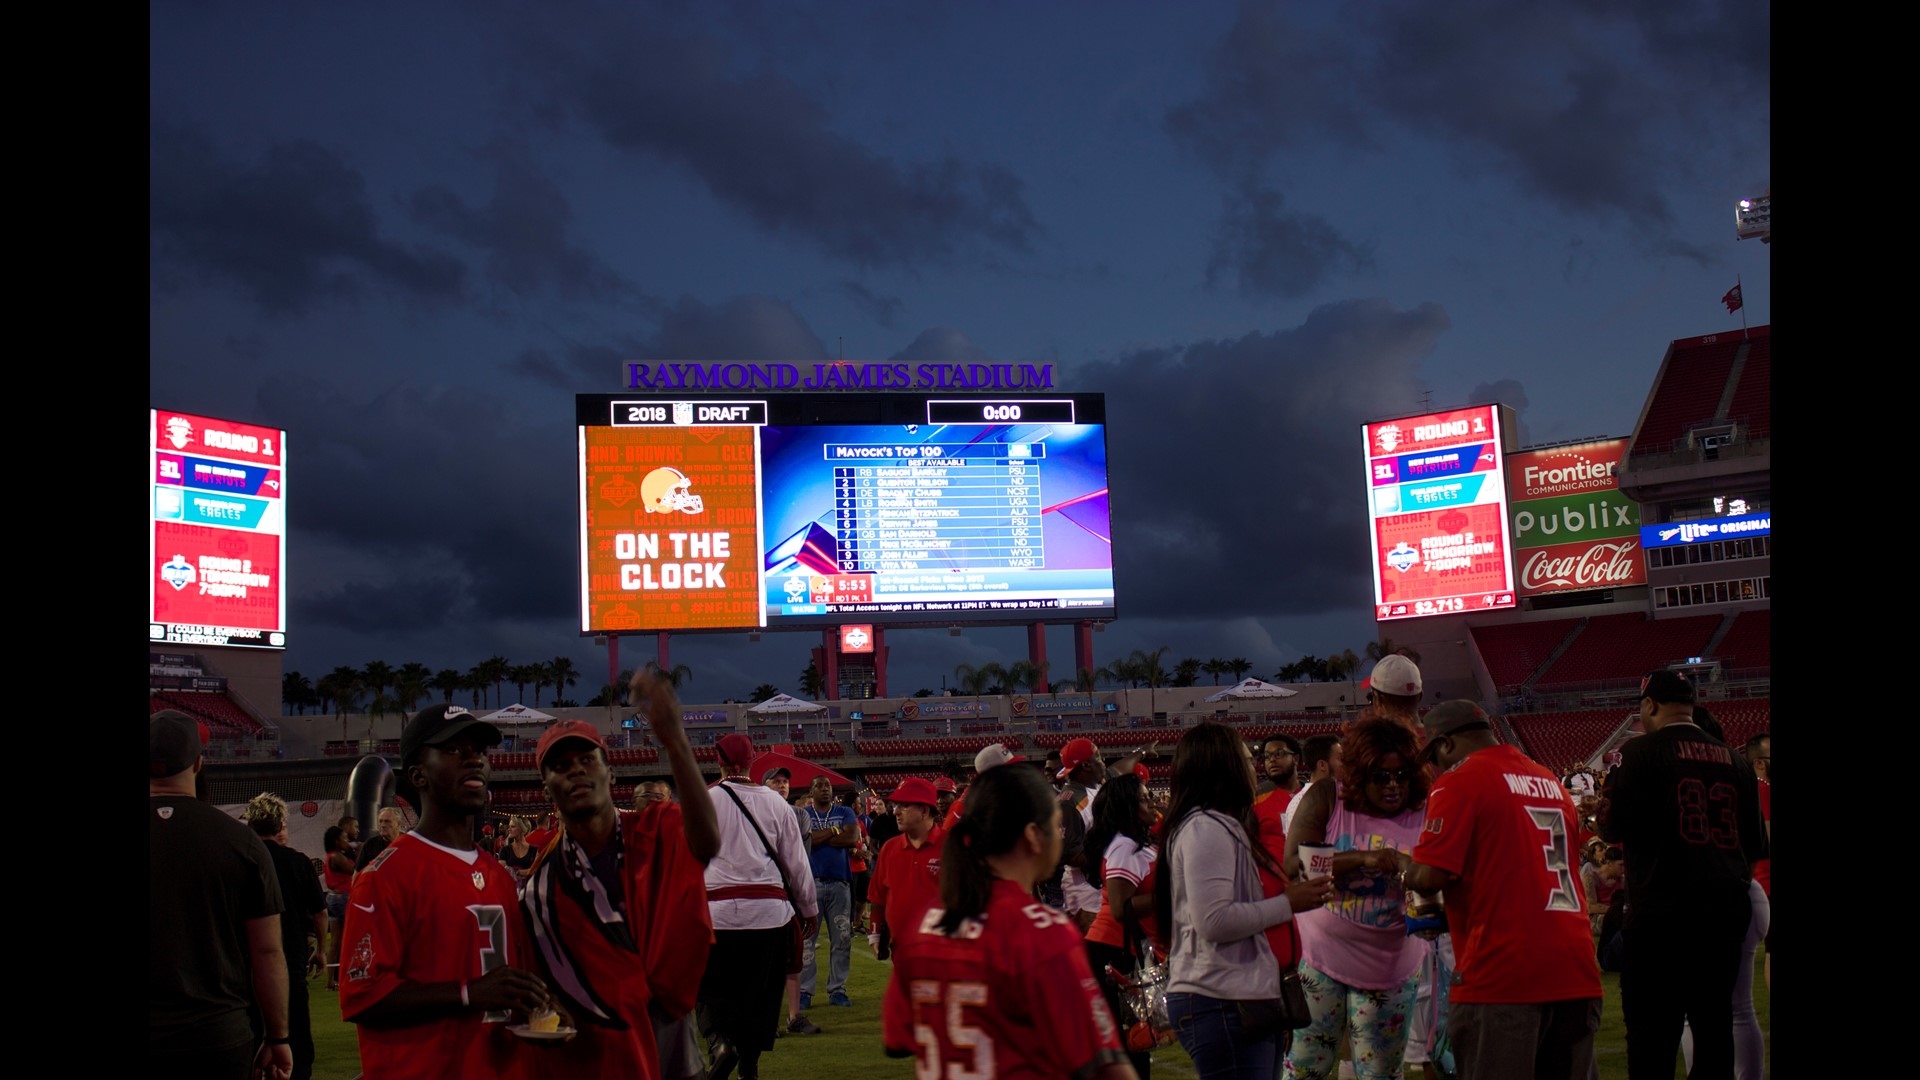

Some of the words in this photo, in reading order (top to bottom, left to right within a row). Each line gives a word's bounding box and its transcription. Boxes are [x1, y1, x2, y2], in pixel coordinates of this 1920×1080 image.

[628, 362, 798, 389] RAYMOND
[803, 362, 911, 389] JAMES
[917, 362, 1054, 389] STADIUM
[628, 407, 666, 421] 2018
[698, 407, 749, 421] DRAFT
[983, 405, 1020, 420] 0:00
[1414, 420, 1469, 442] ROUND
[1472, 417, 1486, 433] 1
[204, 429, 258, 453] ROUND
[262, 438, 274, 456] 1
[626, 444, 683, 462] BROWNS
[919, 446, 941, 457] 100
[842, 468, 848, 477] 1
[860, 469, 872, 477] RB
[1008, 467, 1026, 475] PSU
[1374, 464, 1395, 479] 31
[1409, 460, 1461, 475] PATRIOTS
[1524, 460, 1616, 487] Frontier
[195, 471, 246, 488] PATRIOTS
[842, 478, 850, 487] 2
[1011, 477, 1024, 485] ND
[1526, 478, 1613, 495] COMMUNICATIONS
[842, 489, 850, 497] 3
[860, 490, 873, 498] DE
[1007, 487, 1029, 496] NCST
[1416, 490, 1458, 504] EAGLES
[842, 499, 850, 508] 4
[861, 500, 873, 508] LB
[1009, 498, 1028, 506] UGA
[199, 506, 241, 520] EAGLES
[843, 509, 850, 518] 5
[864, 510, 871, 518] S
[1010, 508, 1028, 516] ALA
[843, 519, 850, 529] 6
[865, 520, 872, 528] S
[1011, 517, 1029, 526] FSU
[843, 530, 850, 539] 7
[861, 530, 875, 539] QB
[1011, 528, 1030, 536] USC
[1679, 523, 1709, 542] Lite
[615, 533, 658, 559] ON
[669, 531, 731, 558] THE
[843, 541, 850, 549] 8
[866, 541, 872, 549] T
[1013, 538, 1028, 546] ND
[1421, 534, 1464, 549] ROUND
[1465, 532, 1474, 544] 2
[844, 551, 851, 560] 9
[861, 552, 877, 560] QB
[1010, 548, 1033, 557] WYO
[1422, 541, 1495, 561] TOMORROW
[843, 561, 854, 570] 10
[863, 561, 876, 570] DT
[1008, 558, 1036, 567] WASH
[1423, 557, 1472, 573] 7:00PM
[1521, 541, 1638, 589] Coca-Cola
[621, 562, 726, 590] CLOCK
[838, 580, 867, 591] 5:53
[787, 596, 804, 604] LIVE
[880, 603, 903, 612] tonight
[913, 602, 925, 610] NFL
[926, 602, 953, 610] Network
[1002, 602, 1019, 610] wrap
[1029, 601, 1040, 609] Day
[1414, 597, 1464, 615] $2,713
[449, 705, 468, 714] NIKE
[1503, 773, 1564, 801] WINSTON
[1677, 777, 1741, 850] 83
[1523, 805, 1581, 912] 3
[910, 979, 996, 1080] 55
